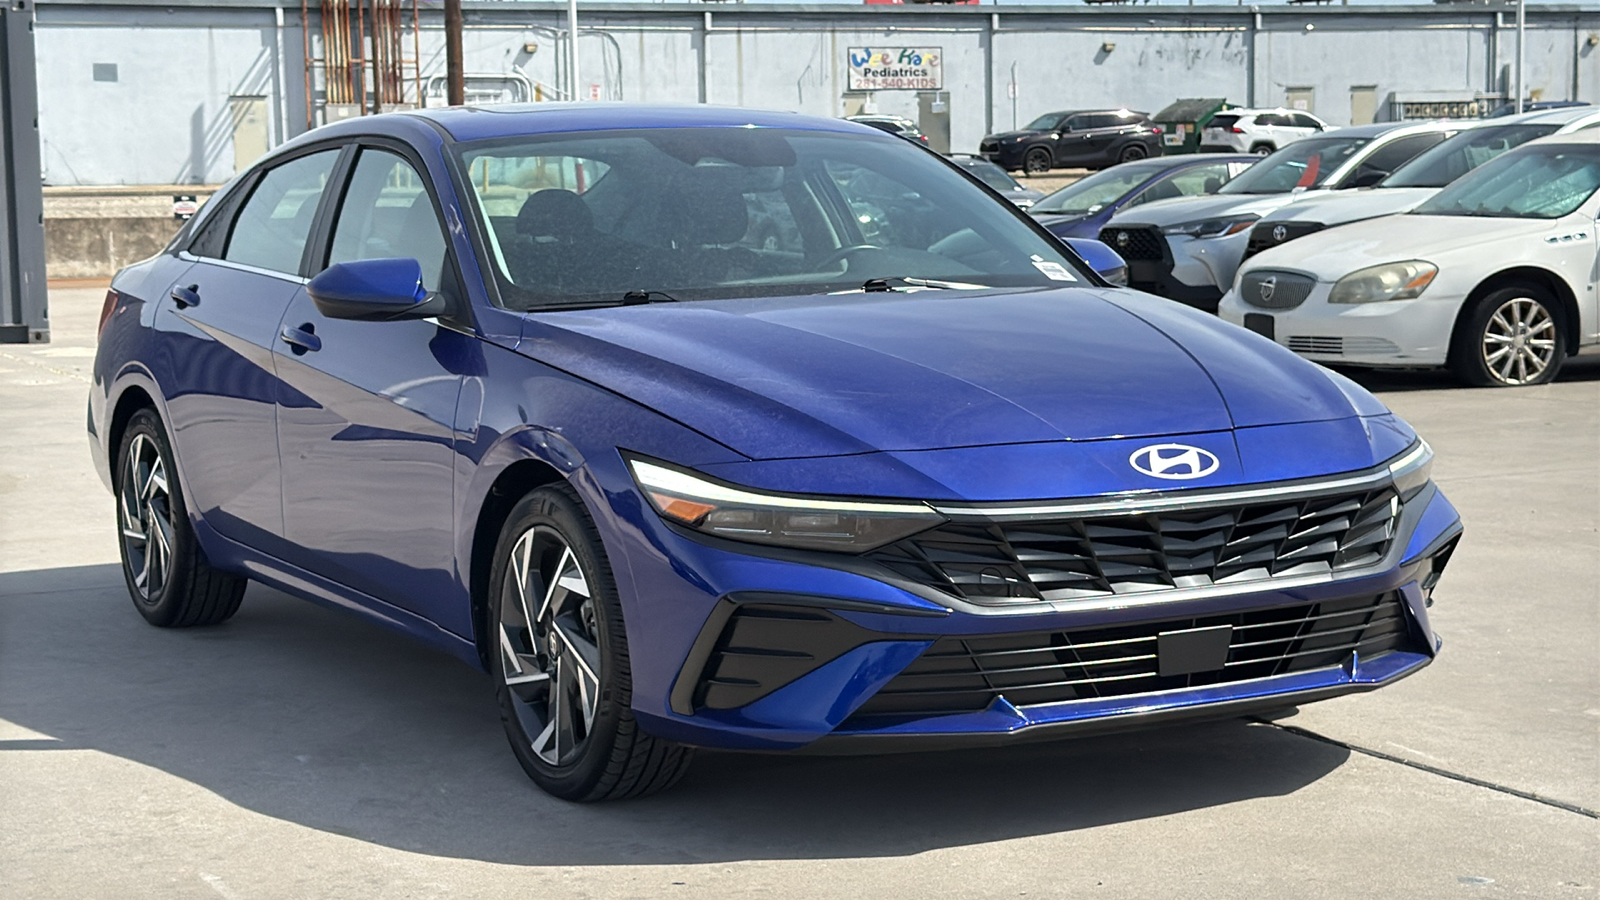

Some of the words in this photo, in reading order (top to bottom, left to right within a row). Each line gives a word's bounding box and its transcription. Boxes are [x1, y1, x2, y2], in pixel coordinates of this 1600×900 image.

[851, 47, 892, 67] Wee
[898, 48, 939, 67] Kare
[863, 67, 928, 77] Pediatrics
[856, 78, 937, 89] 281-540-KIDS
